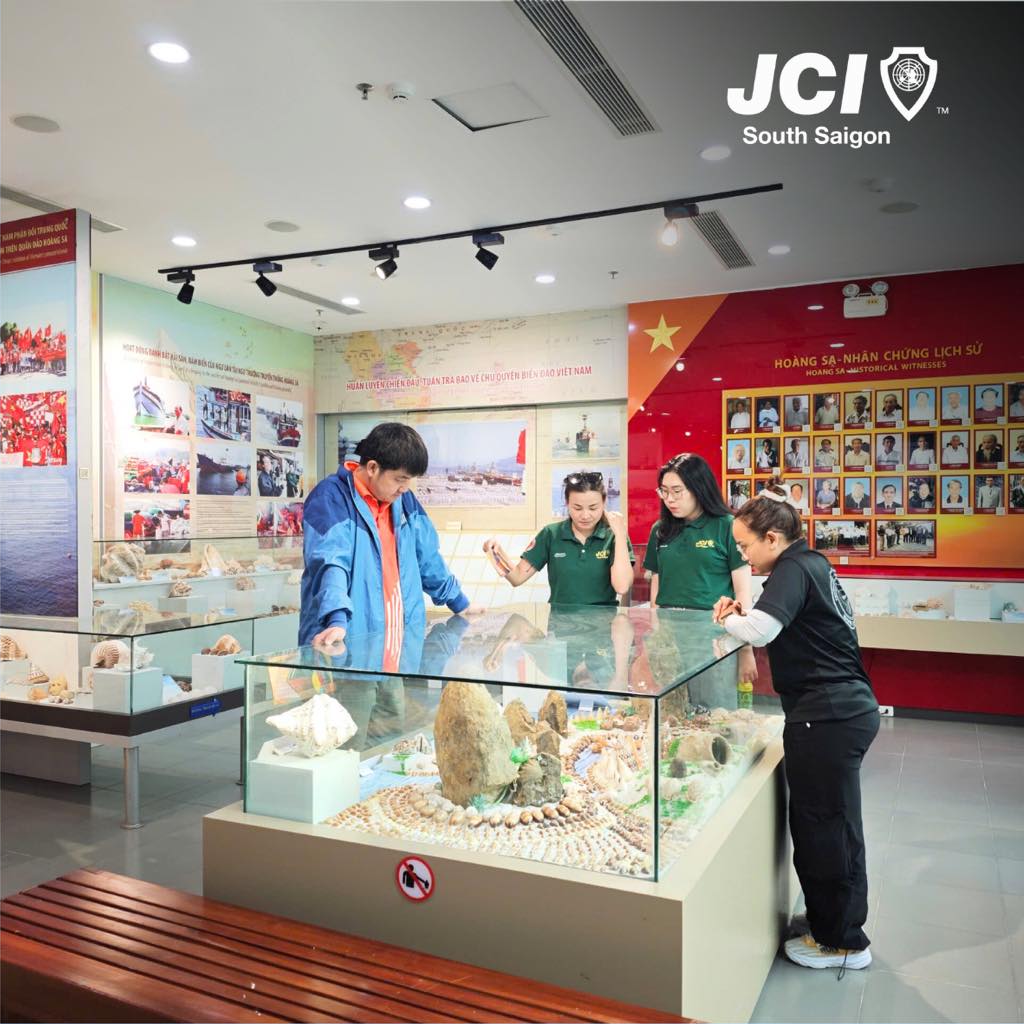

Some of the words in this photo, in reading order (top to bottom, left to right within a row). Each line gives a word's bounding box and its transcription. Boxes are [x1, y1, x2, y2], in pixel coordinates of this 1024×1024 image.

[774, 355, 817, 368] HOÀNG
[884, 346, 929, 361] CHỨNG
[934, 344, 962, 359] LỊCH
[966, 341, 983, 355] SỬ
[574, 366, 592, 376] NAM
[806, 369, 834, 377] HOANG
[835, 367, 845, 375] SA
[901, 360, 947, 370] WITNESSES
